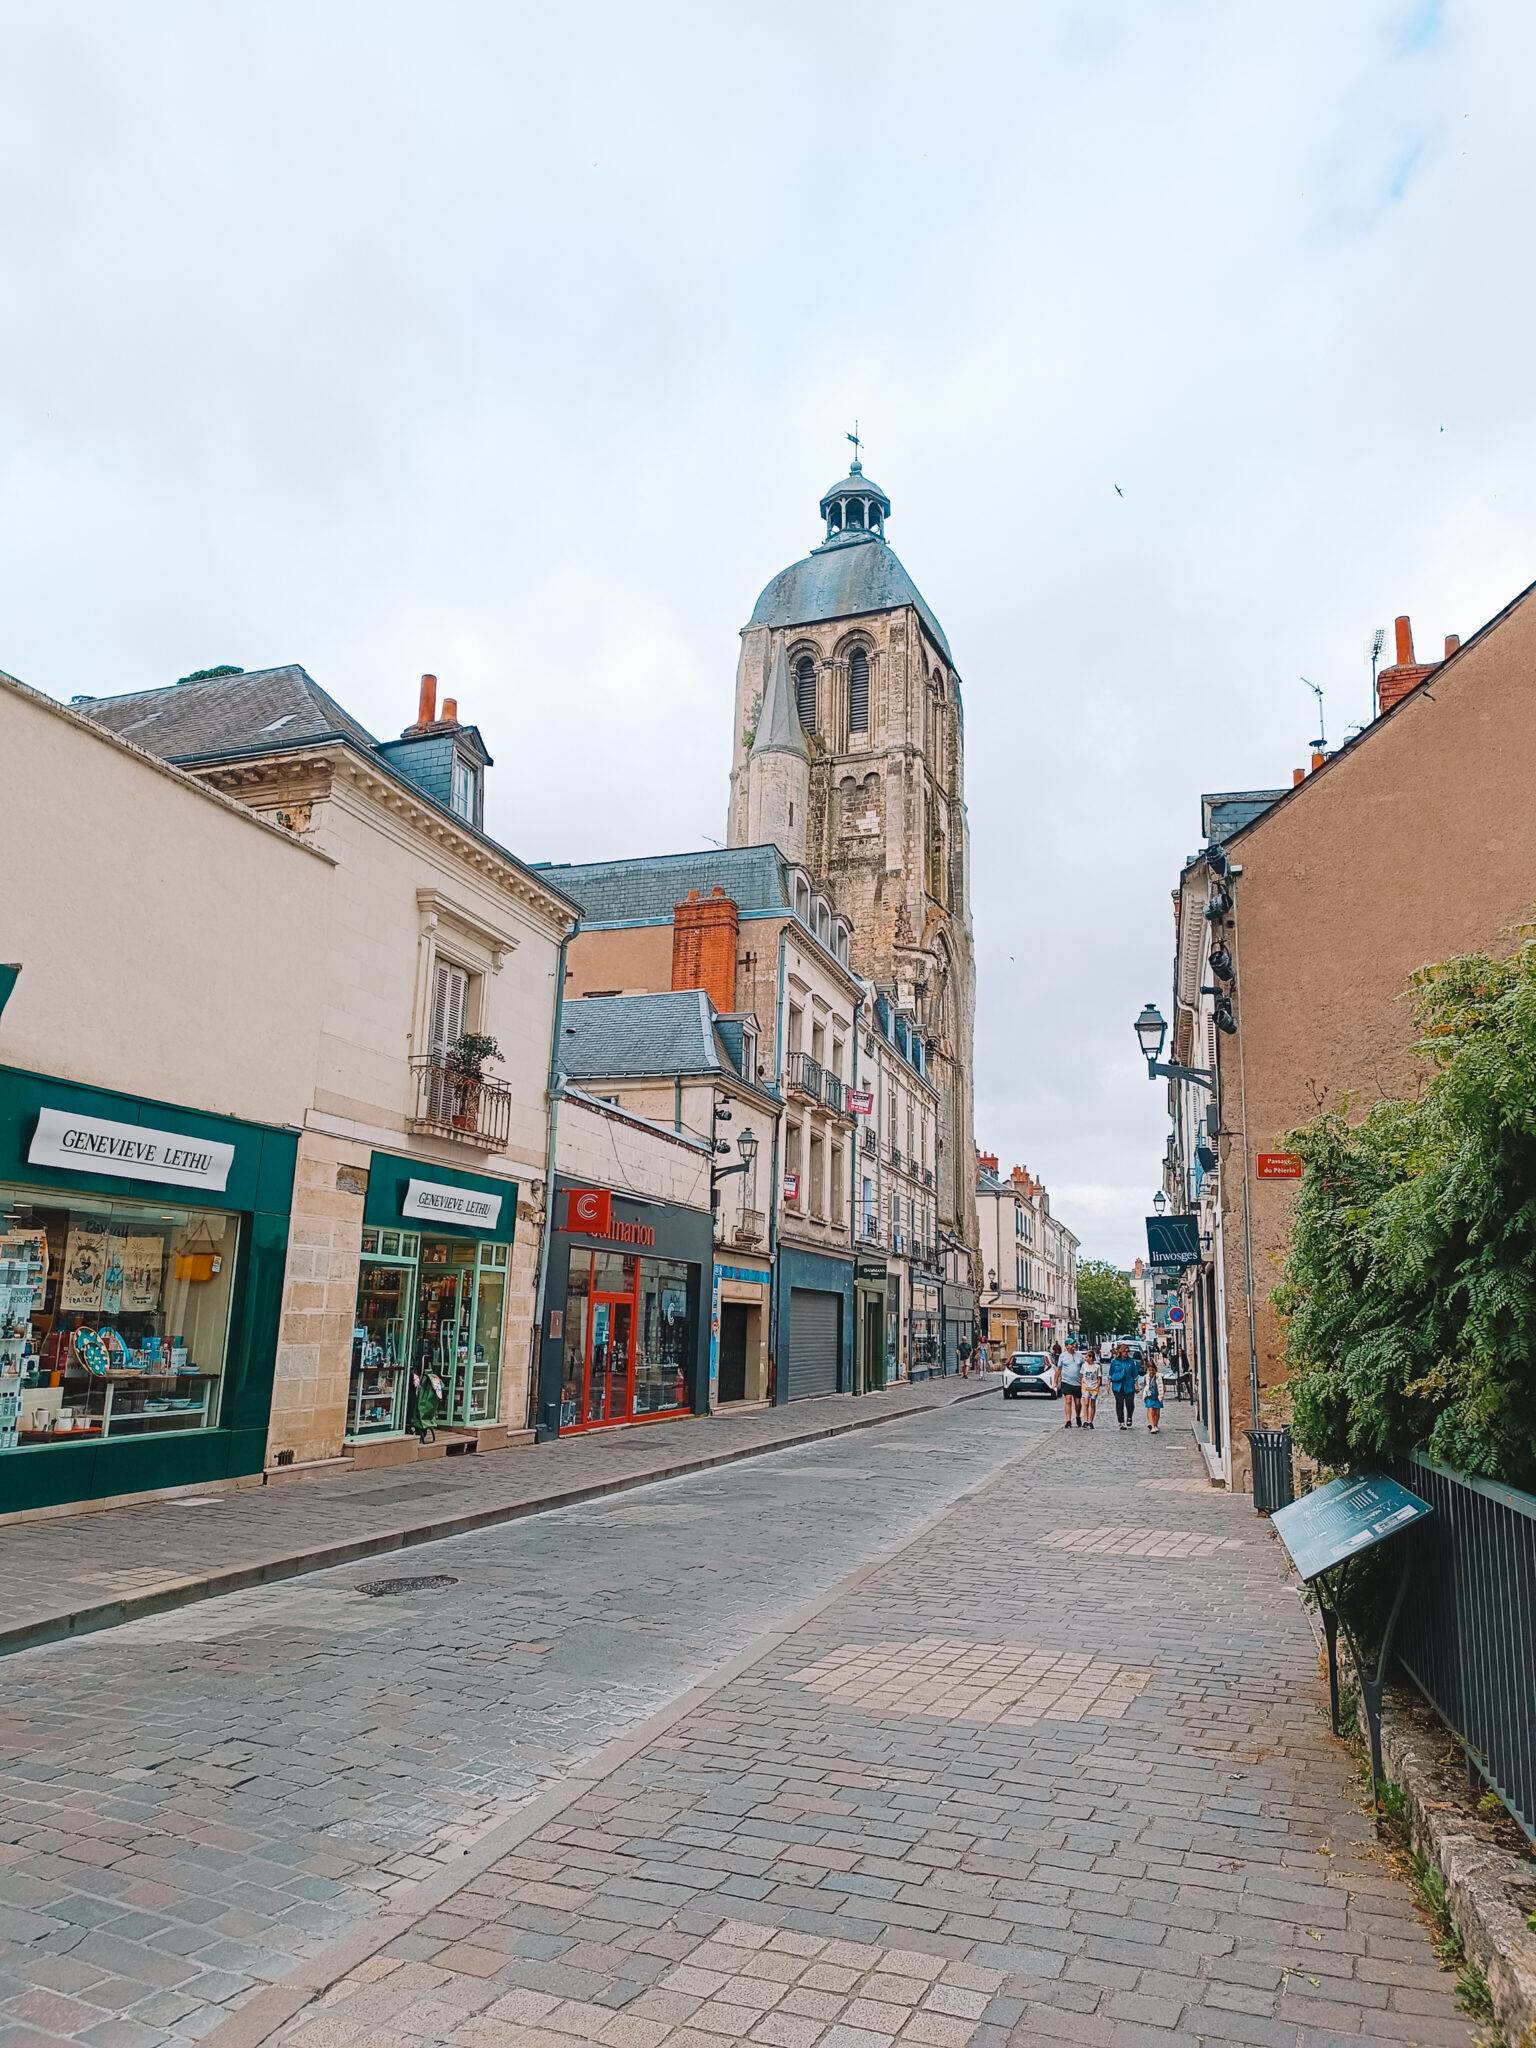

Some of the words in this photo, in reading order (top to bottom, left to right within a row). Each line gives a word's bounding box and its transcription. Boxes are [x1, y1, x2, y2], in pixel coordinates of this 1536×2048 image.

[62, 1129, 158, 1162] GENEVIEVE
[162, 1147, 213, 1171] LETHU
[1264, 1166, 1273, 1174] du
[418, 1191, 465, 1211] GENEVIEVE
[465, 1200, 491, 1216] LETHU
